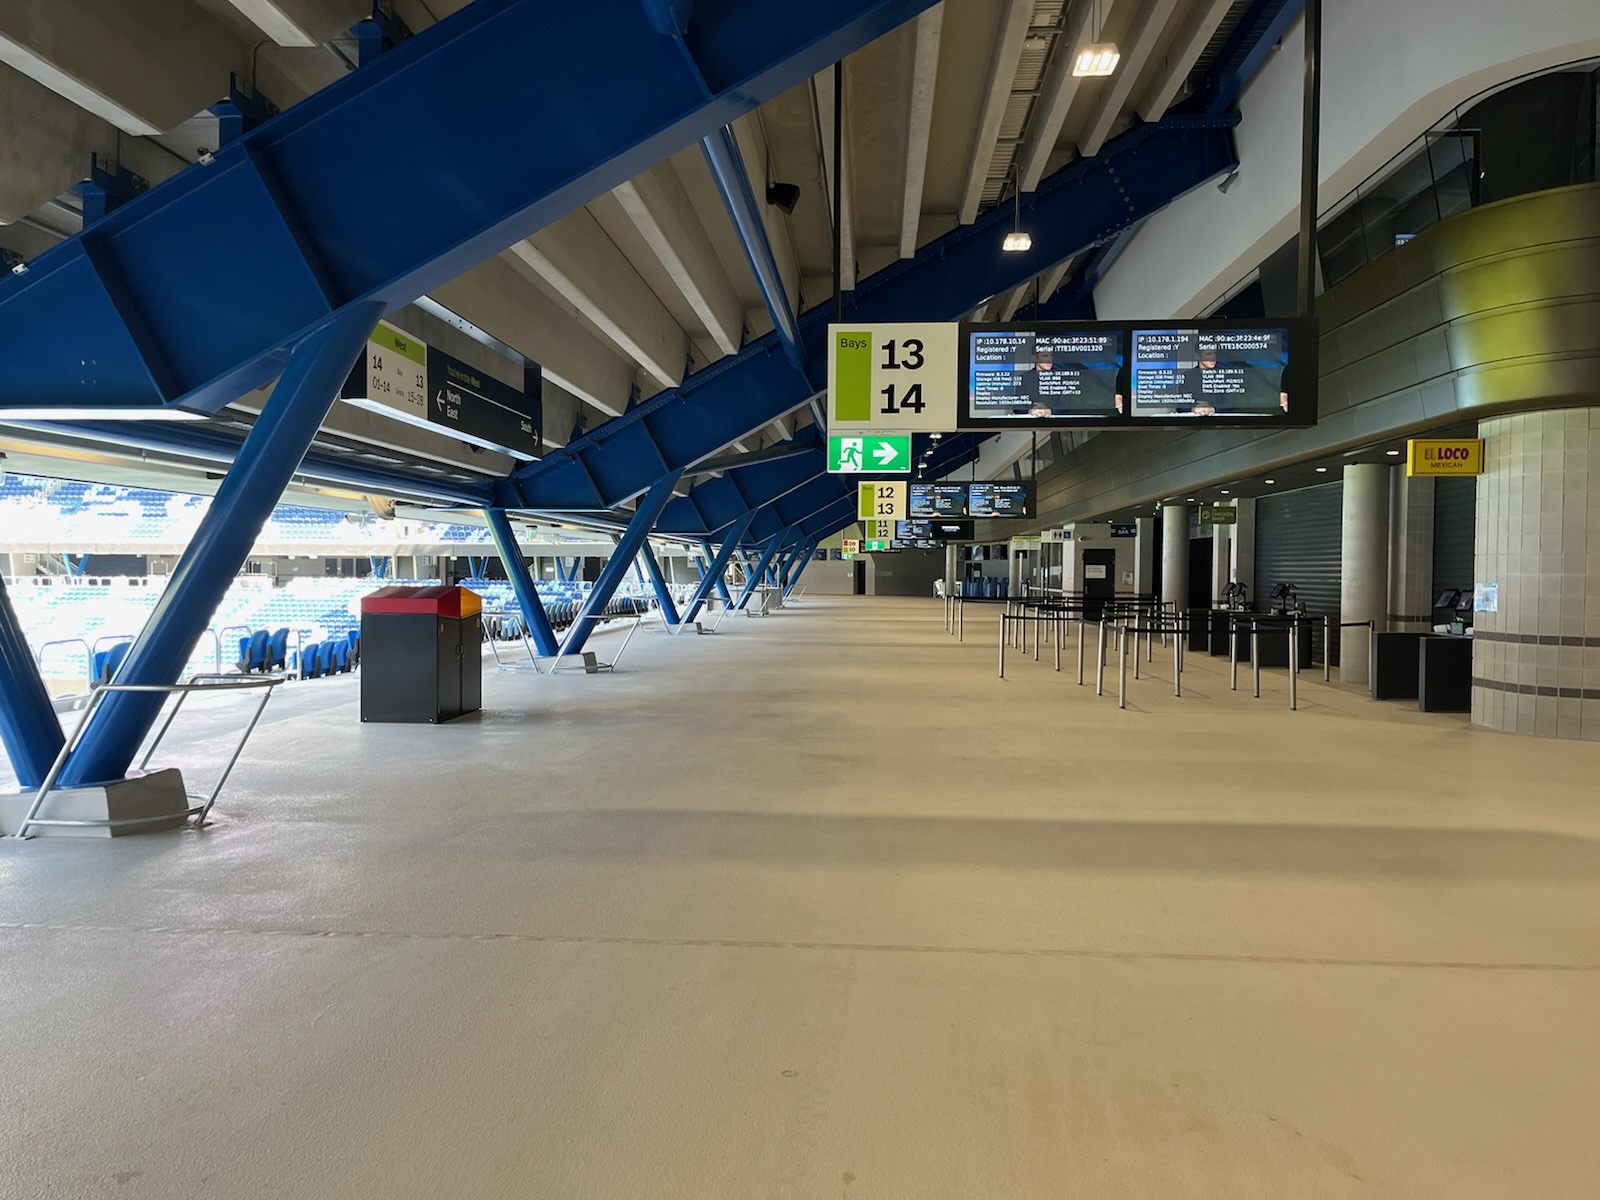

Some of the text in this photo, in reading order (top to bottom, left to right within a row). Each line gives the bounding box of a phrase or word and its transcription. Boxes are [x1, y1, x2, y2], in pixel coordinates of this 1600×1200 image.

[394, 337, 406, 352] West
[840, 338, 867, 350] Bays
[882, 339, 924, 370] 13
[373, 355, 382, 371] 14
[416, 374, 423, 388] 13
[373, 376, 390, 392] 01-14
[447, 389, 461, 405] North
[881, 384, 925, 414] 14
[447, 405, 458, 420] East
[521, 420, 532, 433] South
[1425, 448, 1469, 460] EL LOCO
[878, 487, 894, 499] 12
[878, 503, 894, 515] 13
